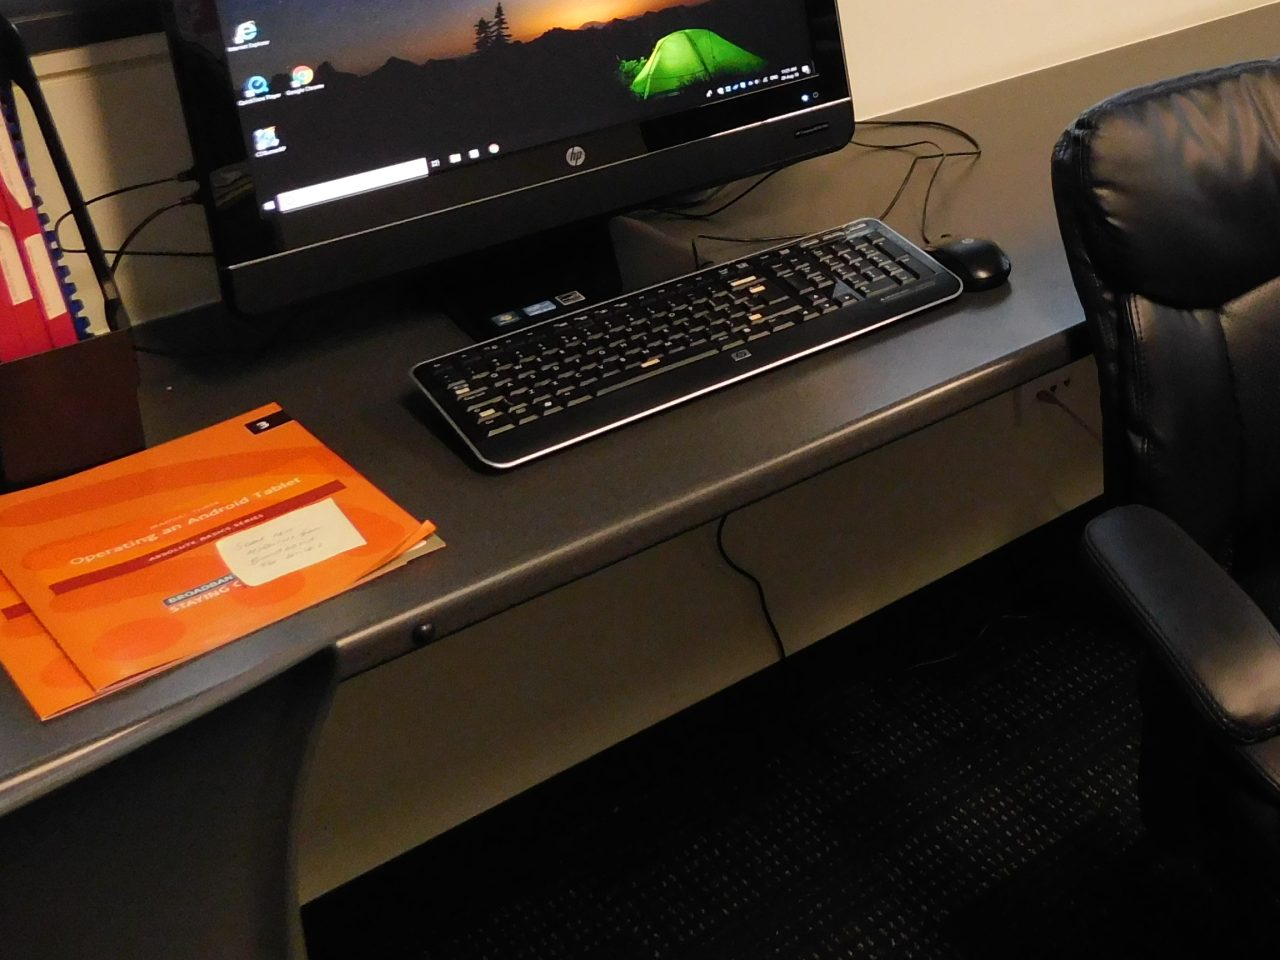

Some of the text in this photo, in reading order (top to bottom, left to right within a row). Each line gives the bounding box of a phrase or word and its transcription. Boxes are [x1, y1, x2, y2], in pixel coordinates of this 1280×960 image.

[568, 146, 584, 166] hp
[256, 421, 270, 430] 3
[70, 533, 159, 565] Operating
[162, 524, 182, 535] an
[188, 496, 249, 526] Android
[254, 477, 301, 498] Tablet
[148, 540, 196, 562] ABSOLUTE
[233, 513, 264, 528] SERIES
[167, 573, 235, 604] BROADBAN
[169, 586, 231, 614] STAYING
